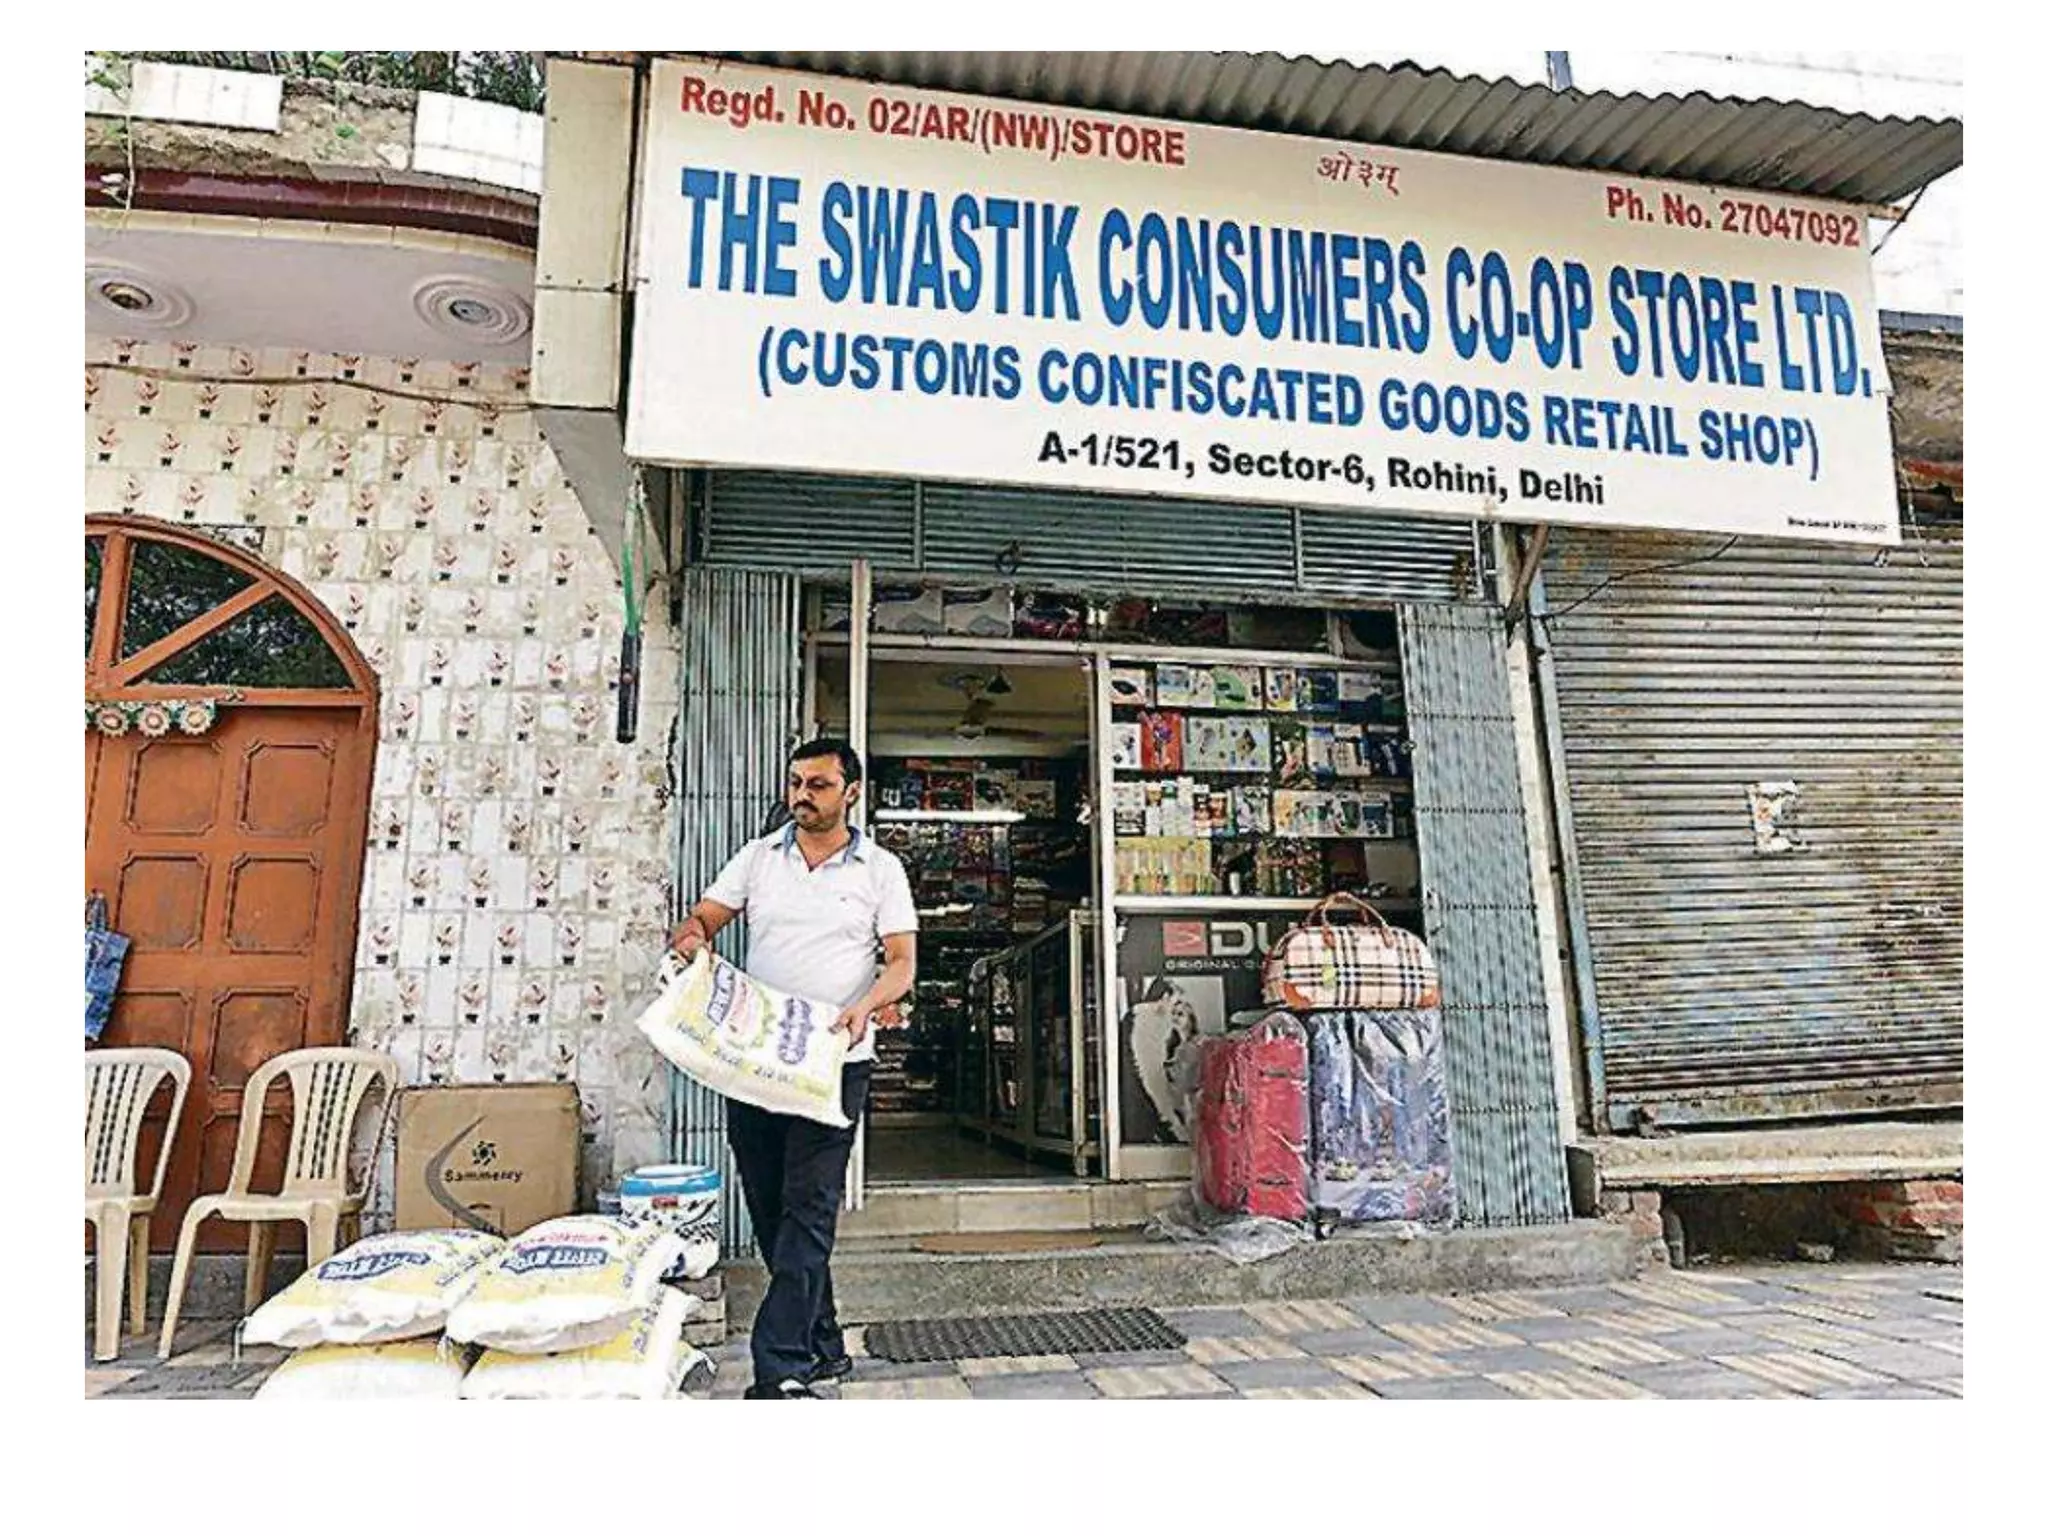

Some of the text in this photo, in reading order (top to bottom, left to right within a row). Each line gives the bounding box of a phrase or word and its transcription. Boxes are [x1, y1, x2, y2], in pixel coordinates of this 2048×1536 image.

[680, 76, 1187, 166] Regd. No. 02/AR/(NW)/STORE
[1607, 184, 1861, 247] Ph. No. 27047092
[681, 167, 1872, 399] THE SWASTIK CONSUMERS CO-OP STORE LTD.
[758, 326, 1820, 481] (CUSTOMS CONFISCATED GOODS RETAIL SHOP)
[1037, 431, 1605, 506] A-1/521, Sector-6, Rohini, Delhi
